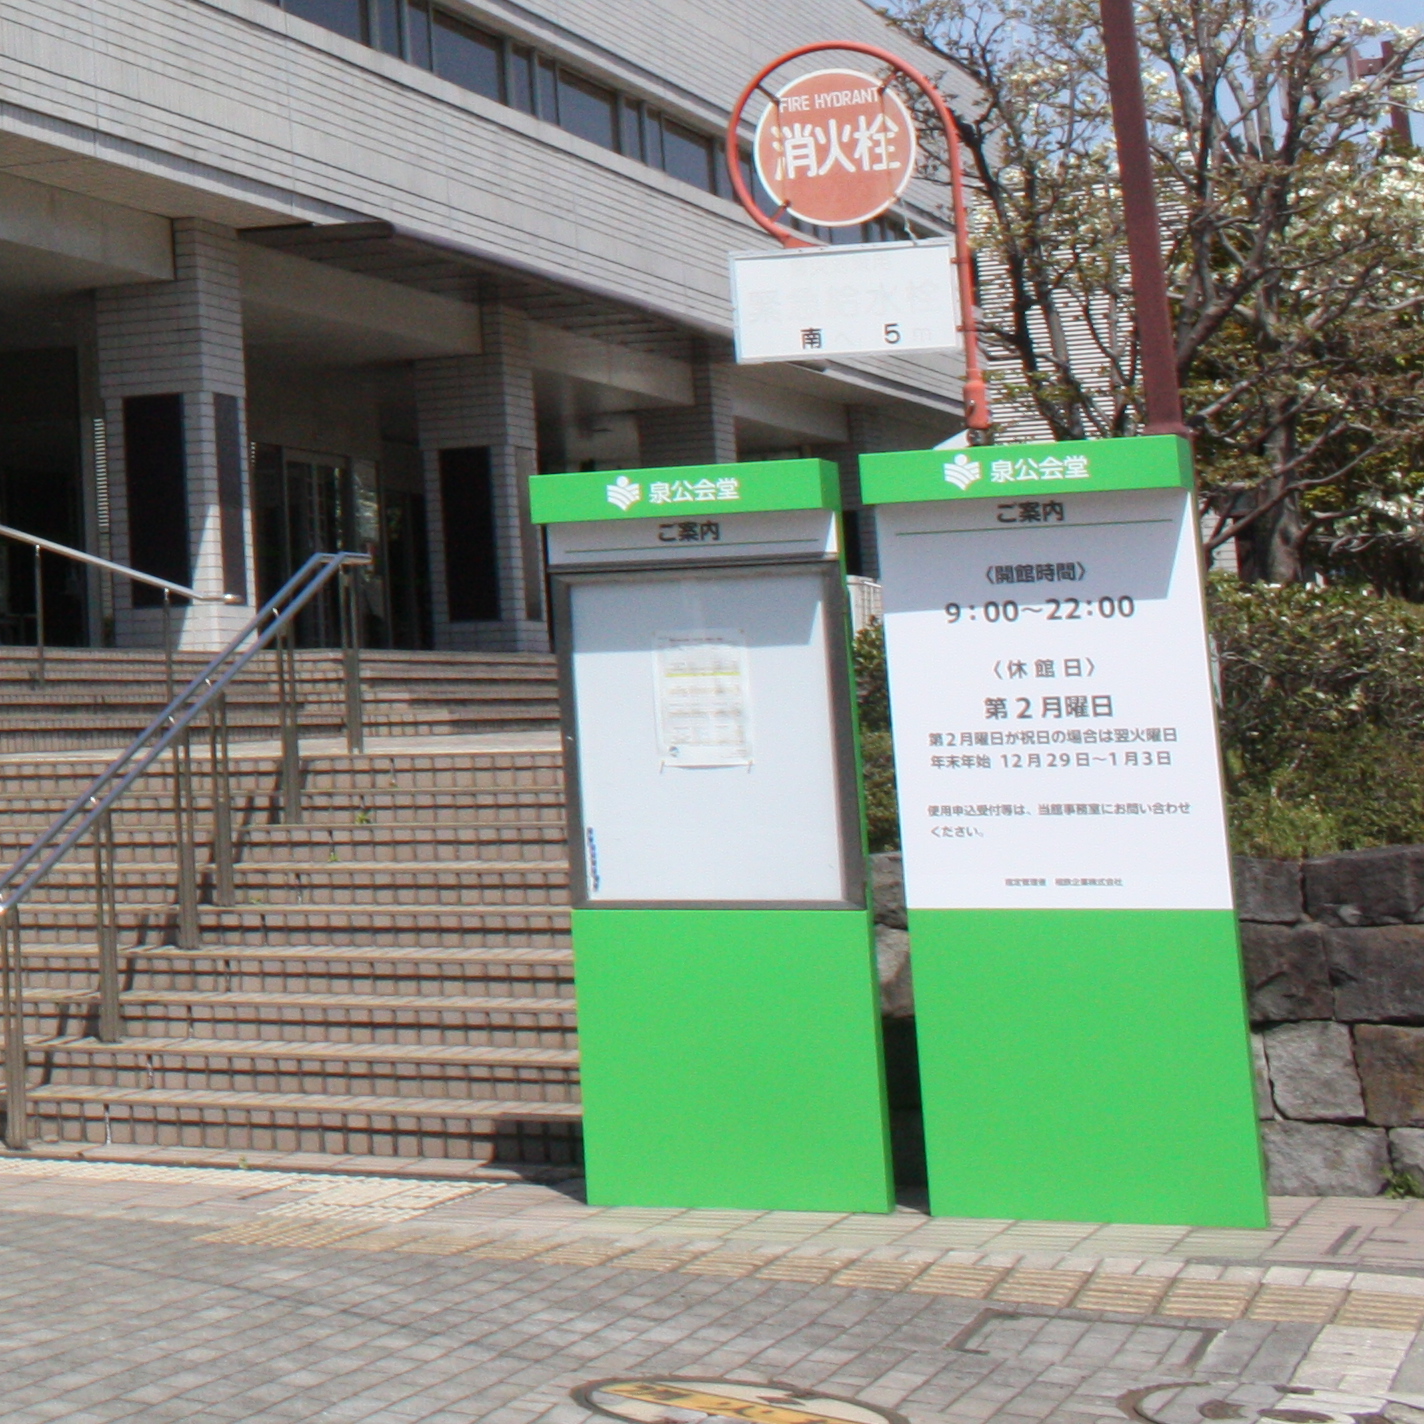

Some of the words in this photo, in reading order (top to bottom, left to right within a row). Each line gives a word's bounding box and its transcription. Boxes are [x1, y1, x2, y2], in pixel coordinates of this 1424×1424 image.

[779, 95, 810, 112] FIRE
[815, 87, 880, 110] HYDRANT
[771, 115, 901, 181] 消火栓
[992, 456, 1088, 482] 泉公会堂
[651, 479, 738, 503] 泉公会堂
[998, 501, 1063, 522] ご案内
[659, 521, 719, 541] ご案内
[929, 728, 1176, 746] 第2月曜日が祝日の場合は翌火曜日
[931, 755, 990, 768] 年末年始
[931, 826, 983, 837] ください。
